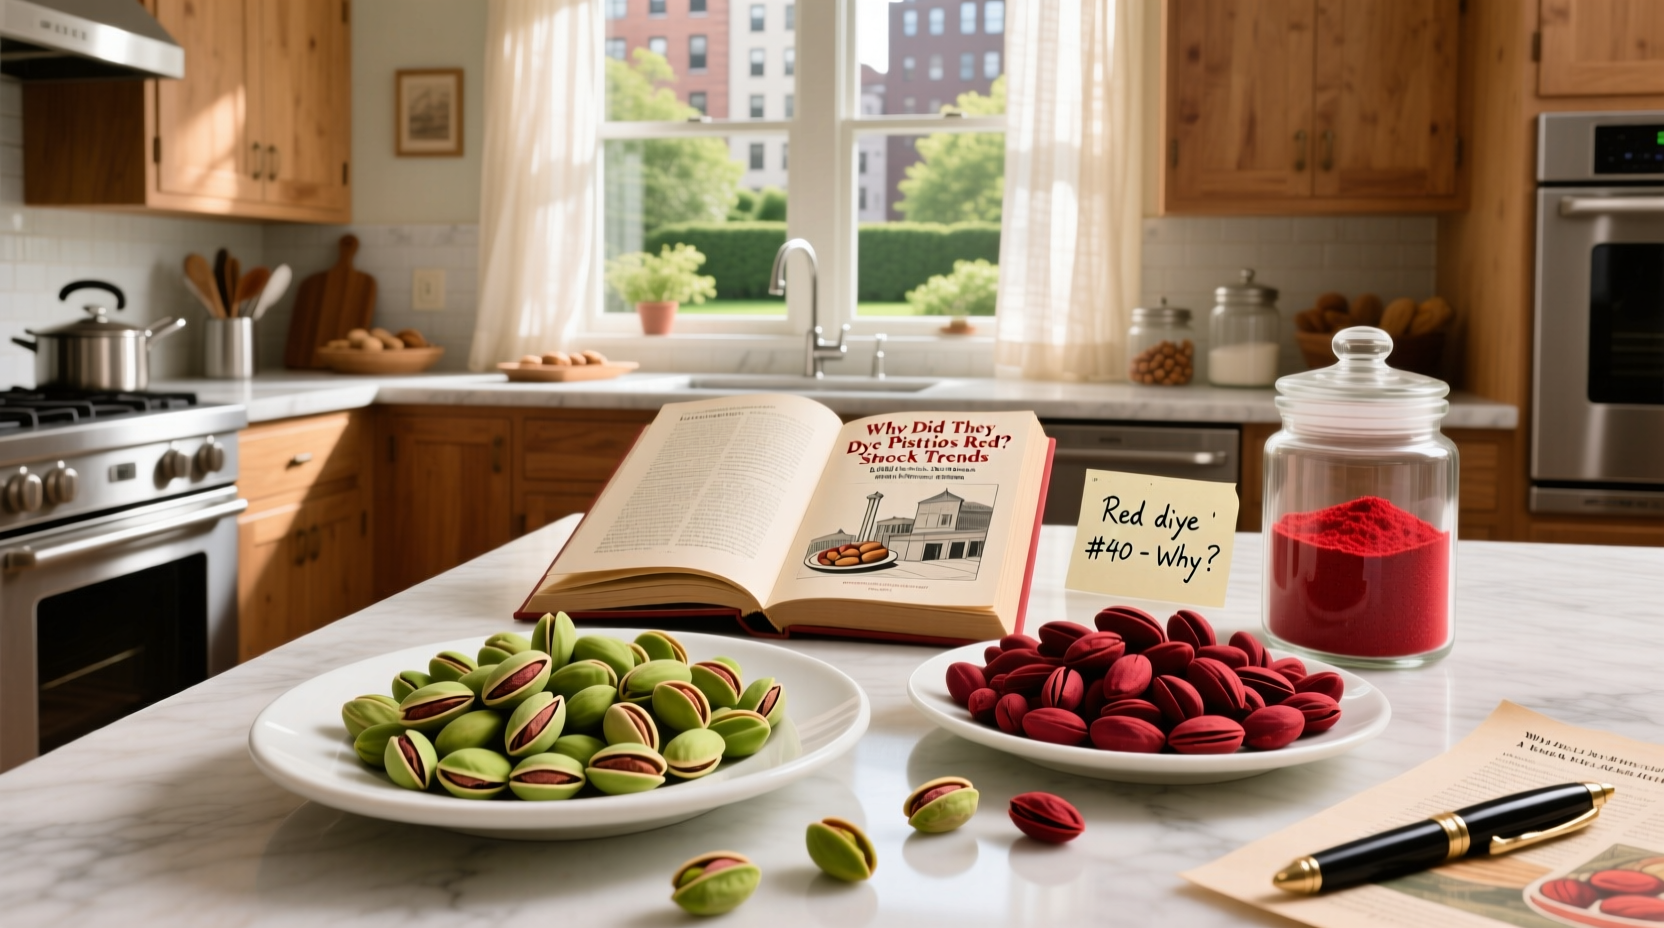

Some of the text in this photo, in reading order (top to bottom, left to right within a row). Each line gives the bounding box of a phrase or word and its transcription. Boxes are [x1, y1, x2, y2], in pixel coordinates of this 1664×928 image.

[867, 420, 996, 436] Why Did They
[888, 435, 959, 449] Pisttios
[963, 435, 1012, 449] Red?
[925, 450, 990, 463] Trends
[1102, 495, 1200, 541] Red diye
